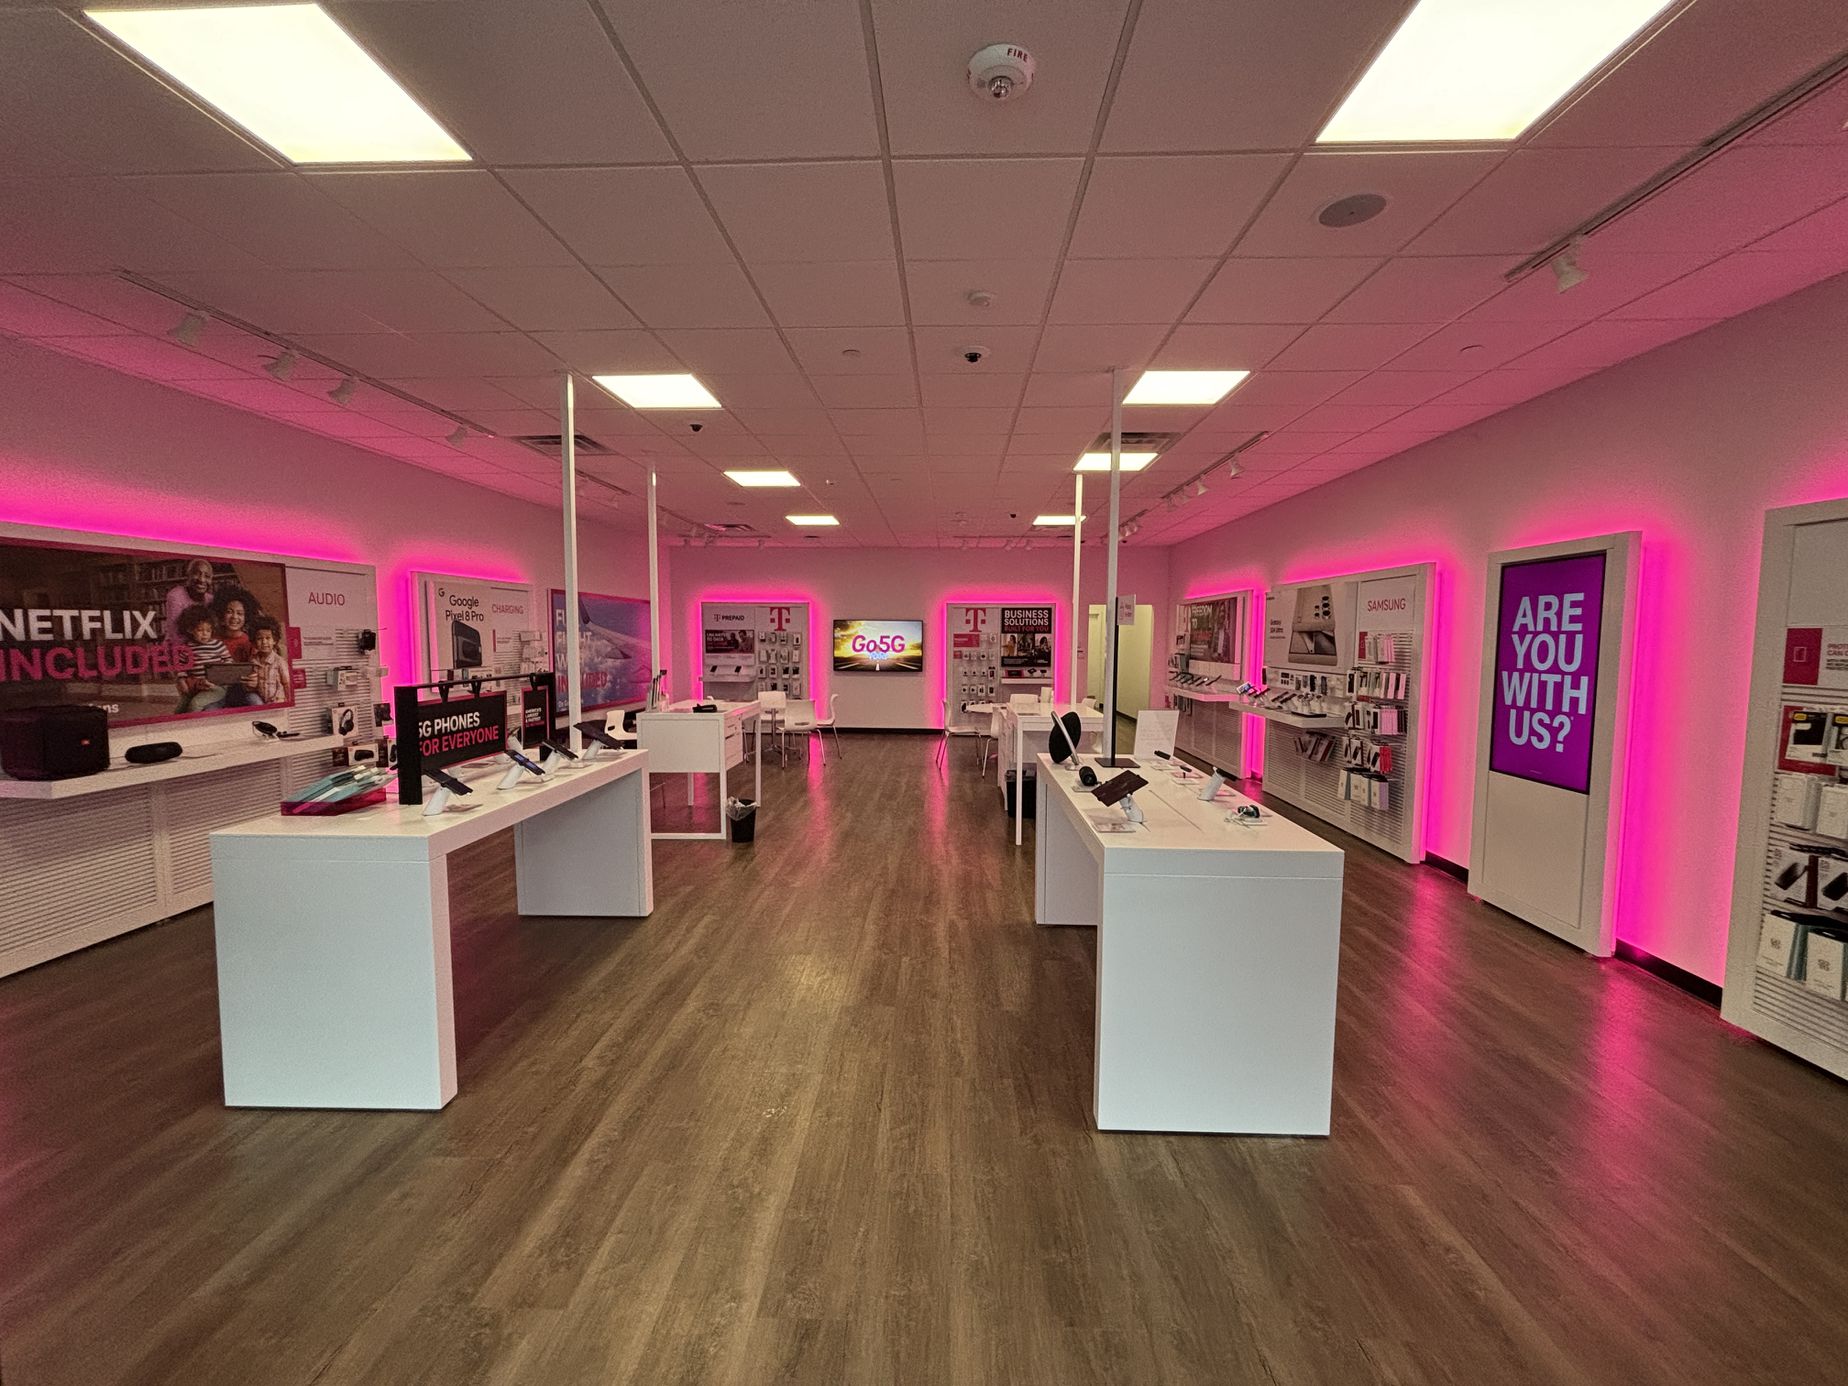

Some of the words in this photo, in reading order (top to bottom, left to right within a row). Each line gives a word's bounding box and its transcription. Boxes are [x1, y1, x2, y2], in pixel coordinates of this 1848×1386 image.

[1007, 48, 1028, 62] FIRE
[308, 592, 345, 606] AUDIO
[449, 595, 479, 609] Google
[492, 604, 524, 614] CHARGING
[1367, 598, 1406, 612] SAMSUNG
[445, 610, 464, 621] Pixel
[465, 610, 470, 621] 8
[471, 611, 484, 621] Pro
[1004, 609, 1049, 619] BUSINESS
[1512, 592, 1585, 632] ARE
[0, 609, 158, 641] NETFLIX
[852, 635, 905, 653] Go5G
[1511, 633, 1584, 673] YOU
[0, 645, 195, 682] INCLUDED
[1502, 671, 1589, 715] WITH
[434, 712, 480, 735] PHONES
[1509, 709, 1572, 752] US?
[442, 725, 499, 752] EVERYONE
